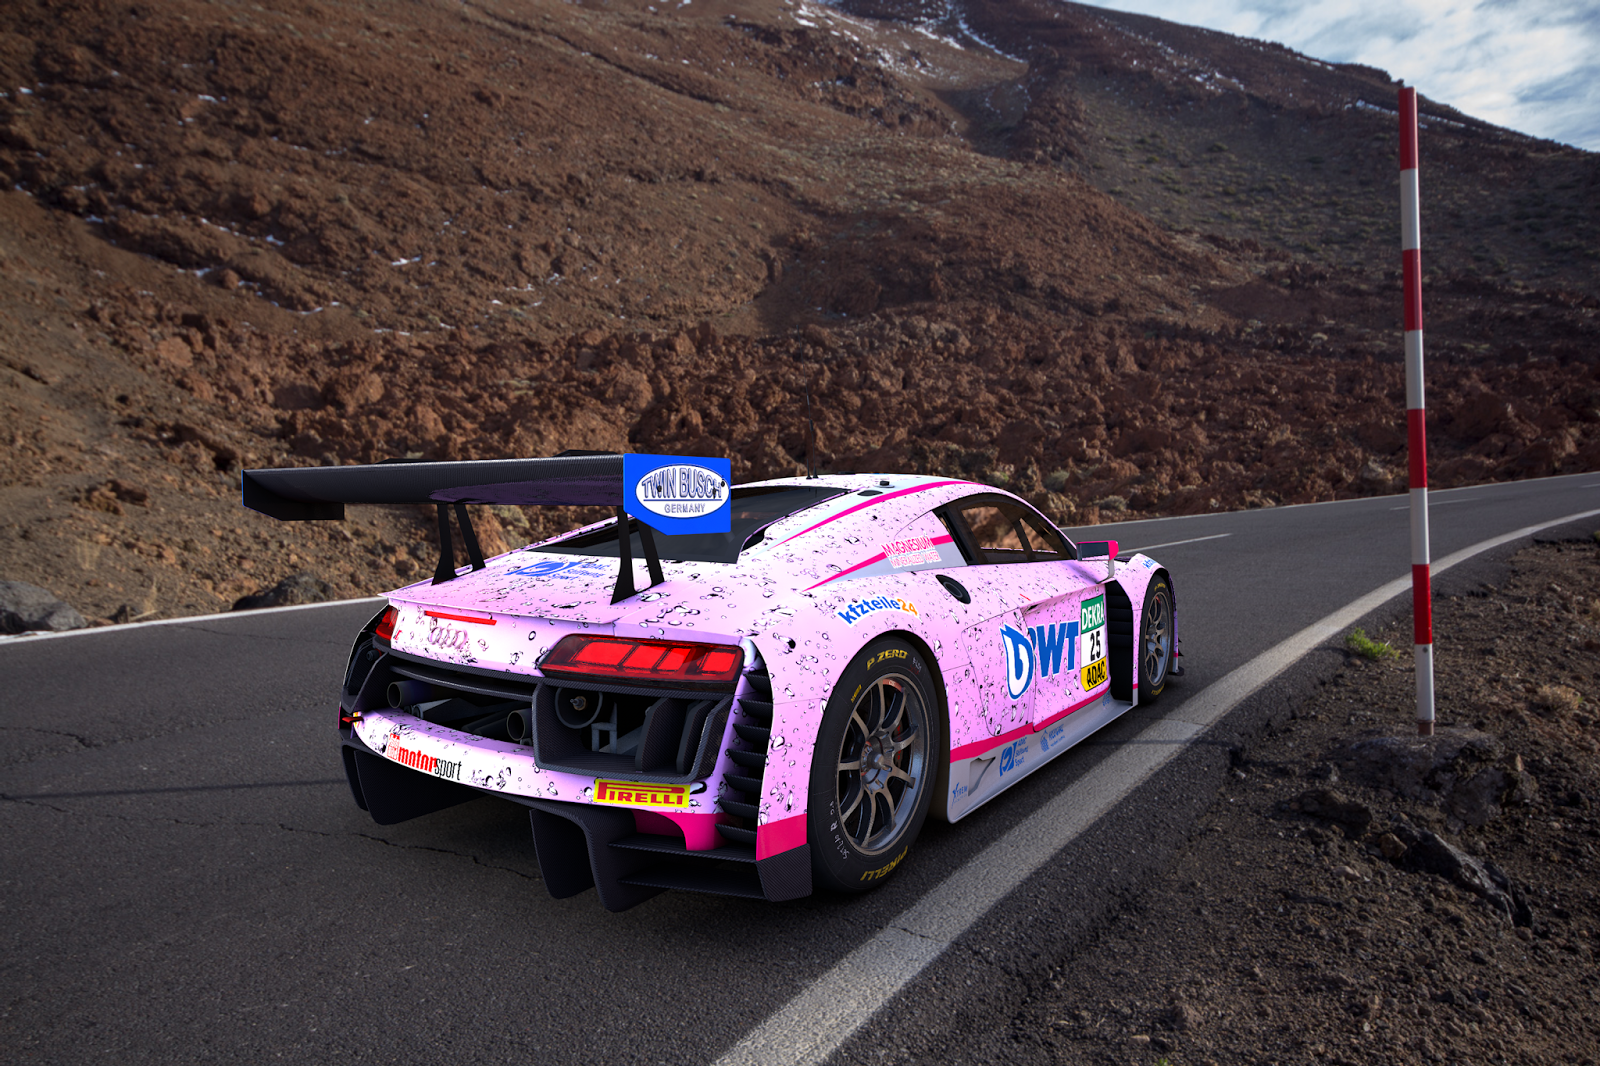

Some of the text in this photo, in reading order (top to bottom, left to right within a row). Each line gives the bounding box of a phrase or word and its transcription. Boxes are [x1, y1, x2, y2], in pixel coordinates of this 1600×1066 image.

[641, 467, 722, 499] TWIN BUSCH
[664, 503, 706, 513] GERMANY
[881, 536, 936, 557] MAGNESIUM
[1081, 601, 1105, 631] DEKRA
[877, 649, 909, 663] ZERO
[1089, 630, 1101, 662] 25
[1086, 660, 1106, 688] ADAC
[596, 781, 686, 805] PIRELLI
[859, 845, 909, 881] PIRELLI
